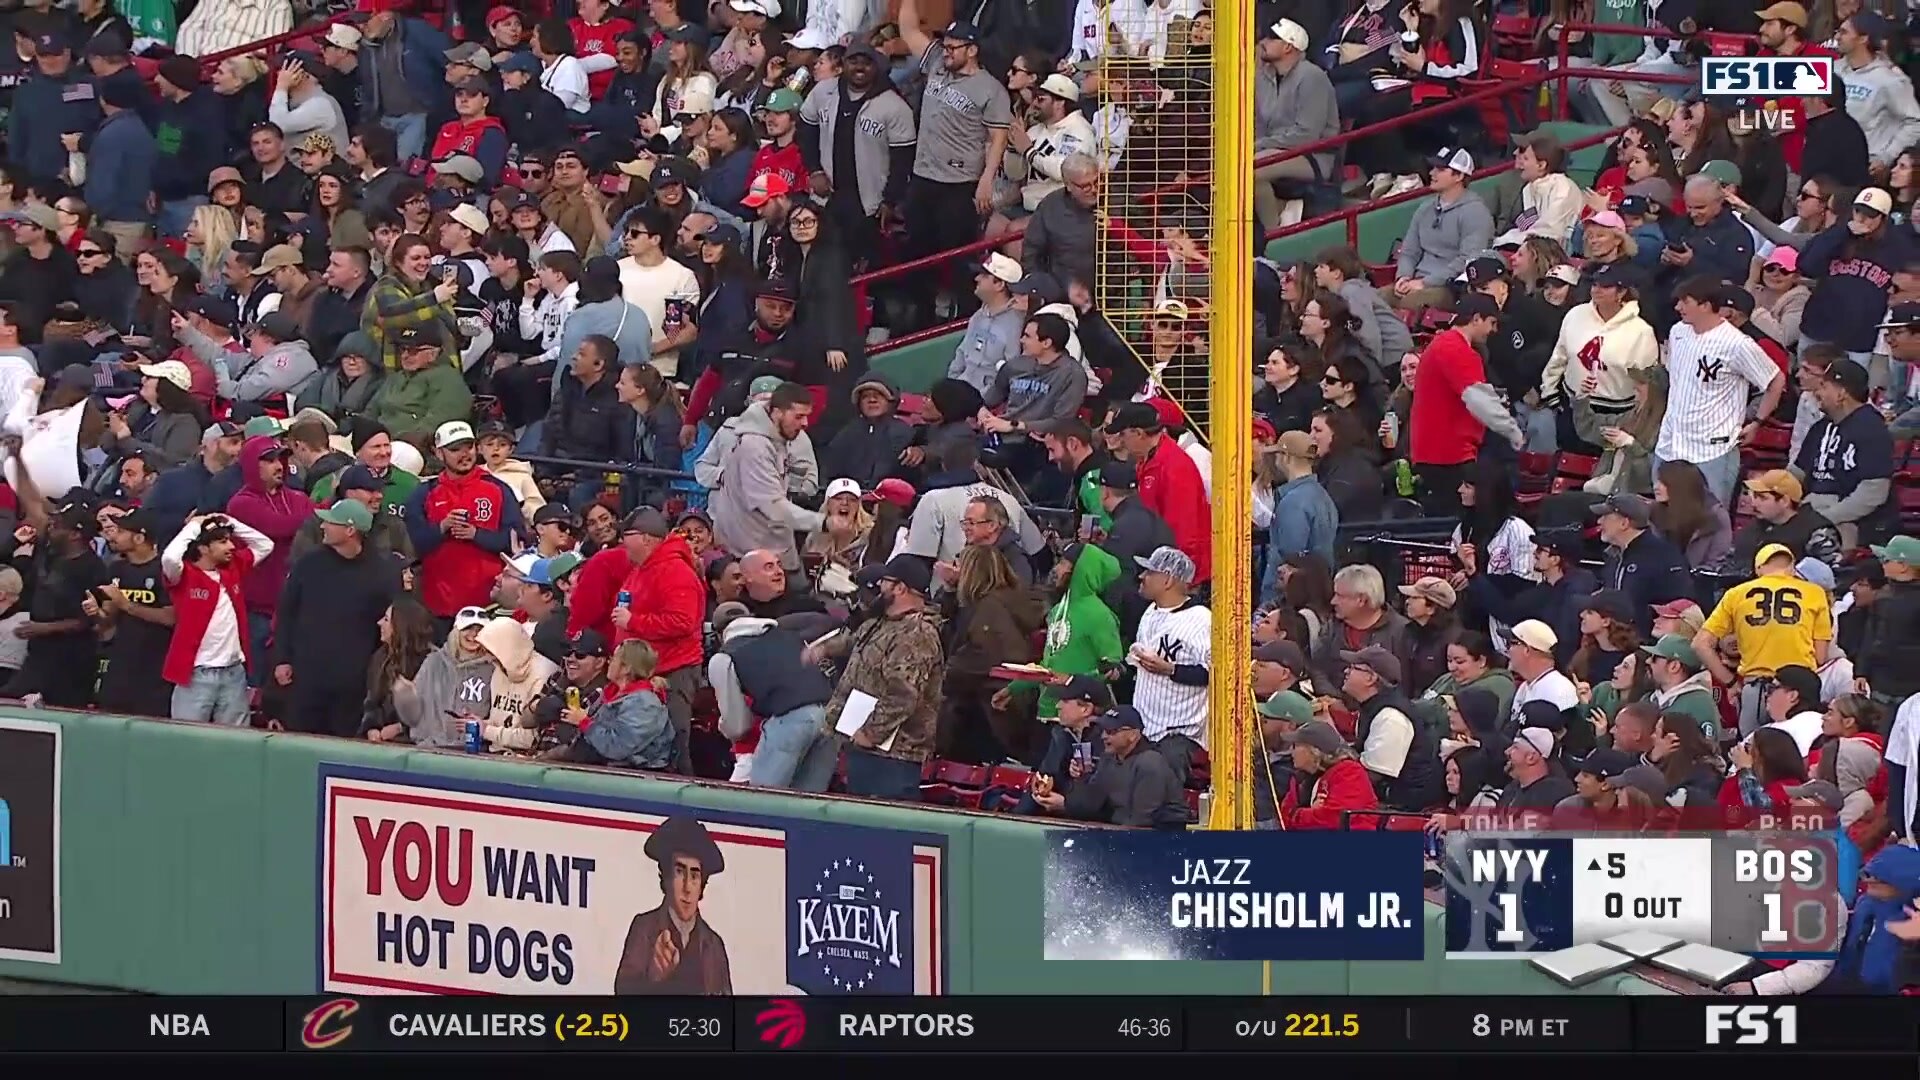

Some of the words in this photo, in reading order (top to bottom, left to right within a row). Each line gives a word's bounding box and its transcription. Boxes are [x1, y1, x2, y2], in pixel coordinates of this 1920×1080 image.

[1829, 259, 1891, 288] BOSTON
[1697, 354, 1723, 383] NY
[474, 497, 493, 522] B
[120, 589, 156, 604] YPD
[1745, 587, 1803, 627] 36
[1157, 634, 1183, 663] NY
[460, 676, 486, 702] NY
[353, 816, 474, 907] YOU
[483, 846, 596, 909] WANT
[797, 898, 900, 968] KAYEM
[377, 911, 455, 970] HOT
[468, 923, 574, 986] DOGS
